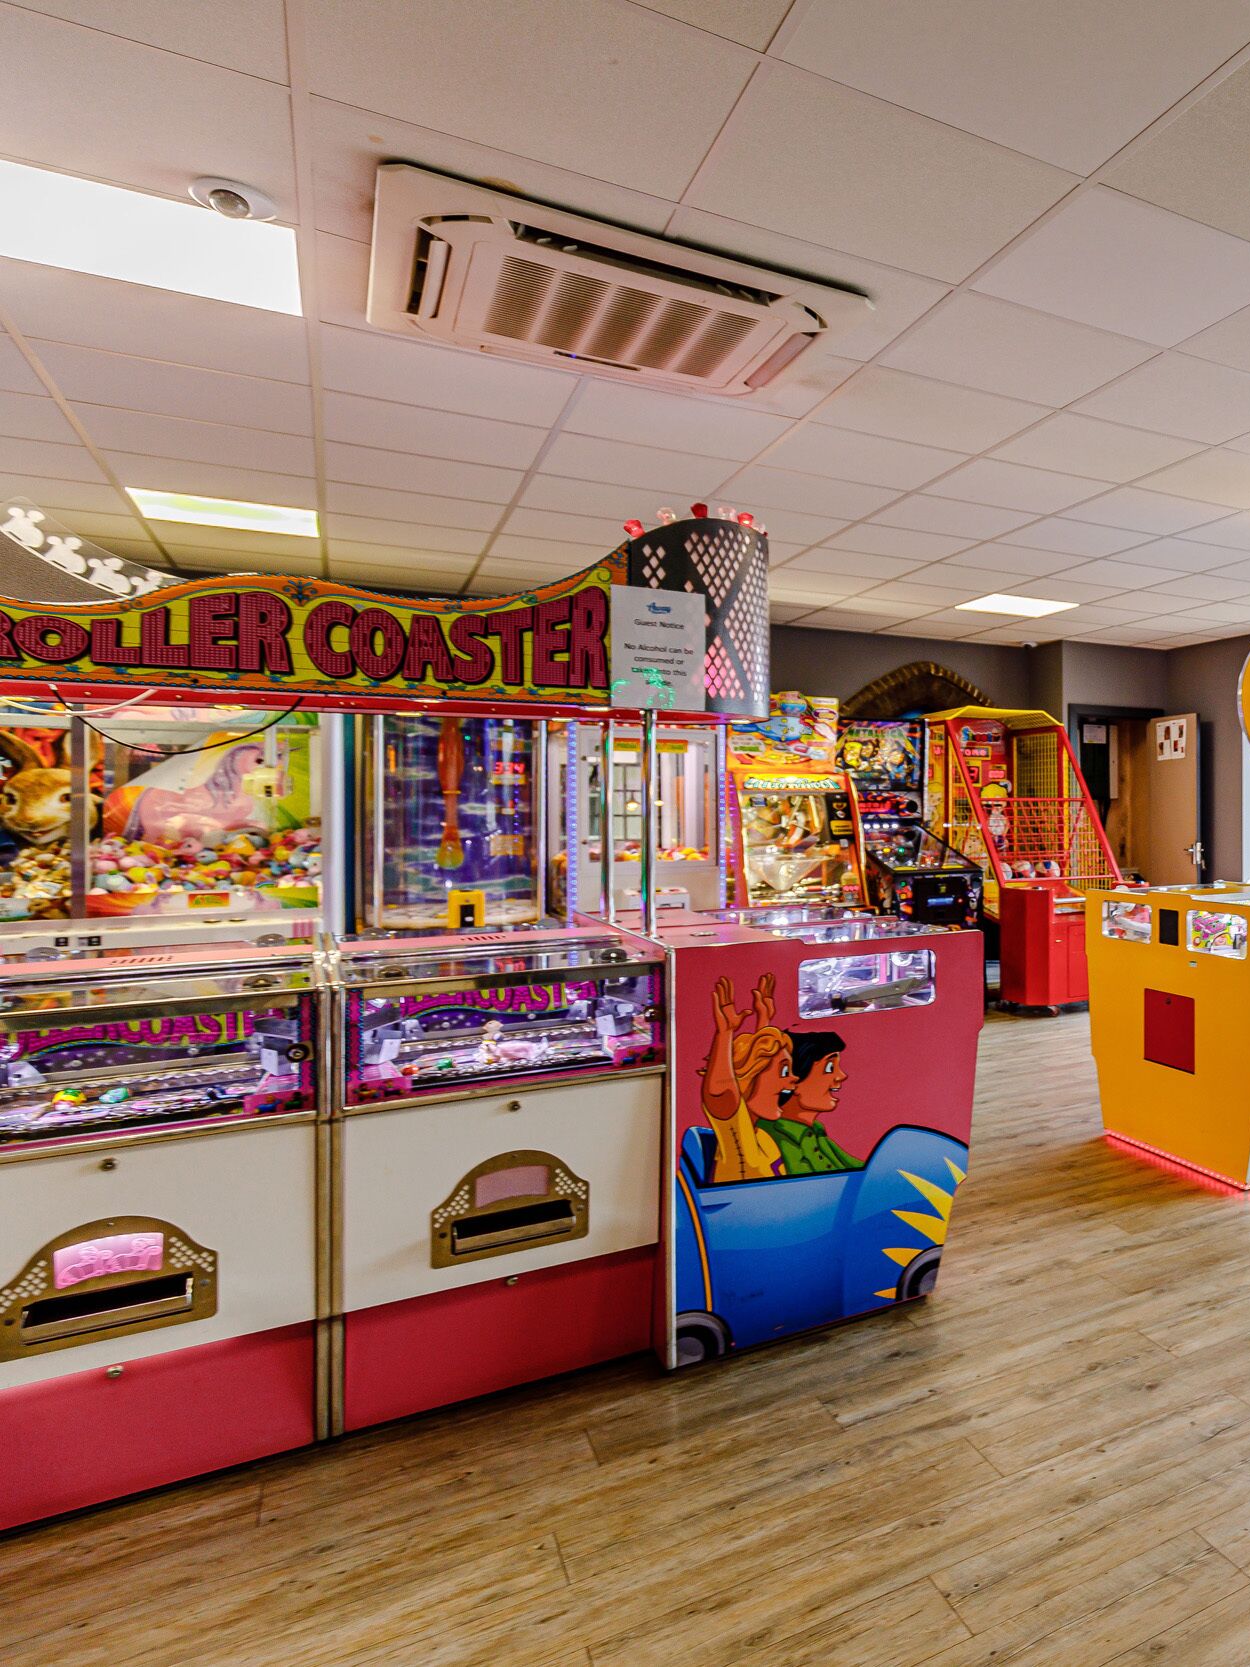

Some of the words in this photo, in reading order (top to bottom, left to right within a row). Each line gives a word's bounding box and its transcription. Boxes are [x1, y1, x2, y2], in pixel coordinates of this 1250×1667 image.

[634, 618, 657, 628] Guest
[660, 621, 685, 630] Notice
[303, 586, 607, 688] COASTER
[624, 642, 636, 651] No
[638, 644, 667, 653] Alcohol
[669, 647, 682, 655] can
[684, 648, 694, 656] be
[634, 656, 675, 665] consumed
